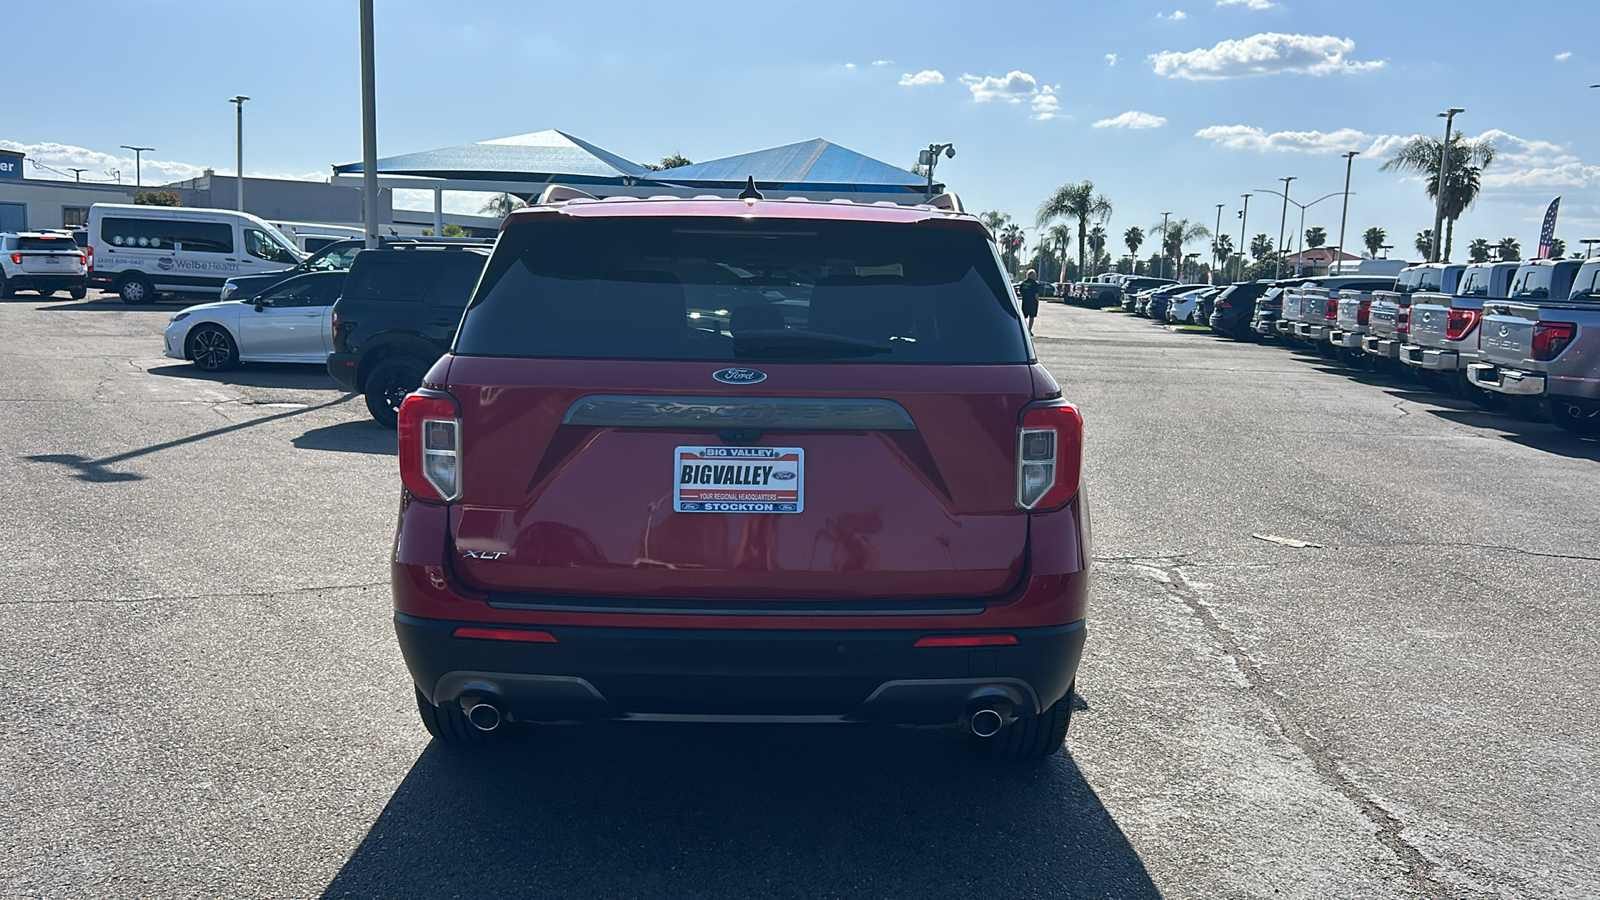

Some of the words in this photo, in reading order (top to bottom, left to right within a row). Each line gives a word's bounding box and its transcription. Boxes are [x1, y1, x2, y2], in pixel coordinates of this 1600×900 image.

[725, 369, 754, 380] Ford
[706, 448, 727, 456] BIG
[730, 449, 773, 457] VALLEY
[680, 464, 773, 485] BIGVALLEY
[713, 493, 738, 501] REGIONAL
[704, 503, 774, 511] STOCKTON
[463, 550, 508, 560] XLT
